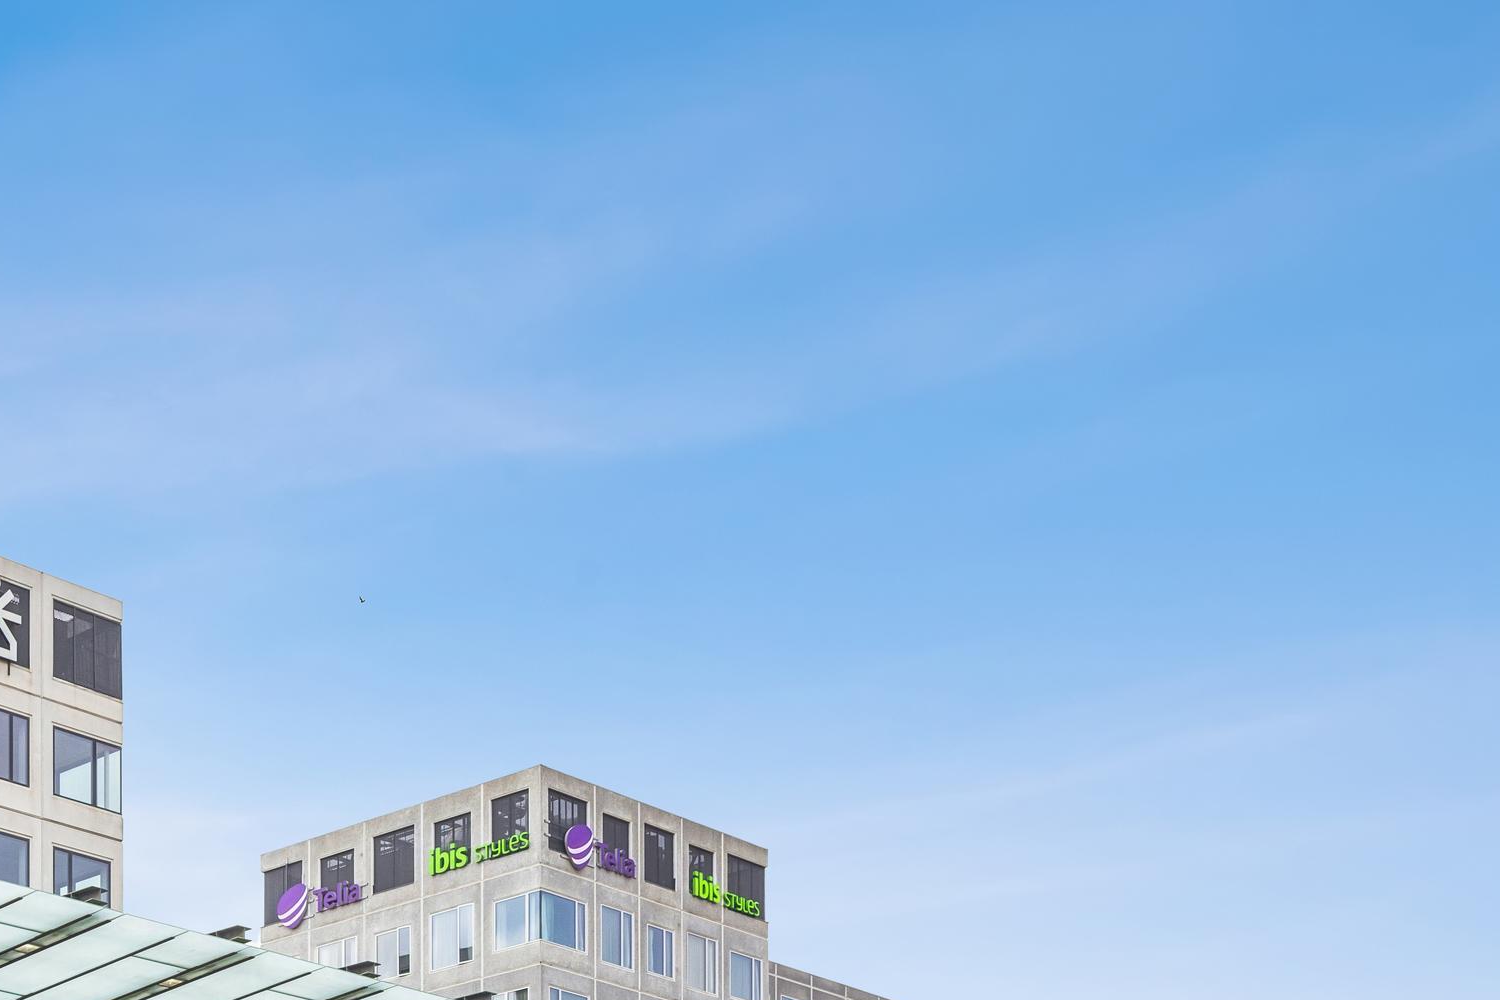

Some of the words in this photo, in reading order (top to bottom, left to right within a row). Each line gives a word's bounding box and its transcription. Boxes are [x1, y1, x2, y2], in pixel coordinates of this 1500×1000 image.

[428, 843, 468, 876] ibis
[595, 842, 637, 879] Telia
[313, 880, 361, 913] Telia
[692, 870, 721, 904] ibis
